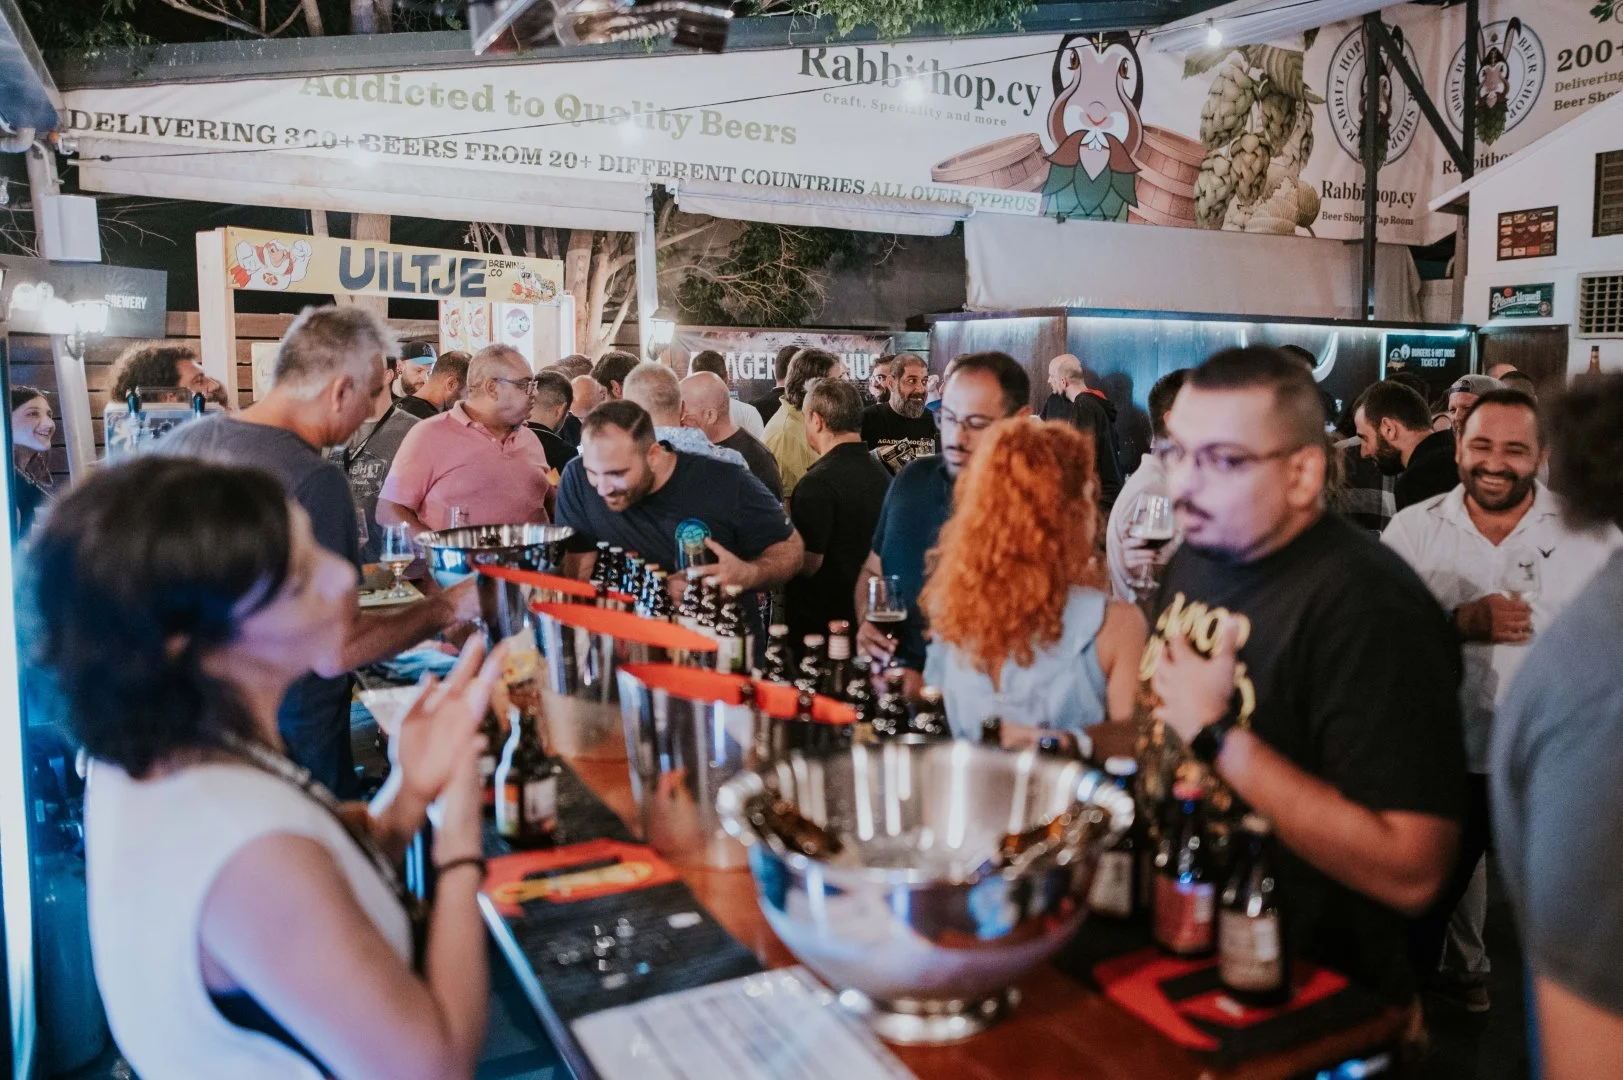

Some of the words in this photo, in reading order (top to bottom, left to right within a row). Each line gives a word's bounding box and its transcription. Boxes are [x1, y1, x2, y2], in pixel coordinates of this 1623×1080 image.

[1339, 39, 1362, 72] HOP
[1517, 36, 1538, 74] BEER
[300, 73, 495, 113] Addicted
[504, 88, 545, 118] to
[554, 92, 693, 141] Quality
[699, 109, 797, 146] Beers
[946, 110, 971, 122] and
[974, 115, 1008, 127] more
[1334, 76, 1357, 144] RABBIT
[1509, 80, 1537, 119] SHOP
[1553, 97, 1586, 112] Beer
[67, 108, 278, 145] DELIVERING
[284, 126, 352, 150] 300+
[360, 132, 458, 160] BEERS
[464, 141, 543, 166] FROM
[548, 149, 592, 170] 20+
[597, 153, 737, 182] DIFFERENT
[741, 168, 866, 196] COUNTRIES
[868, 180, 911, 199] ALL
[911, 184, 964, 205] OVER
[965, 190, 1038, 213] CYPRUS
[1322, 211, 1343, 221] Beer
[1390, 215, 1414, 226] Room
[339, 245, 487, 298] UILTJE
